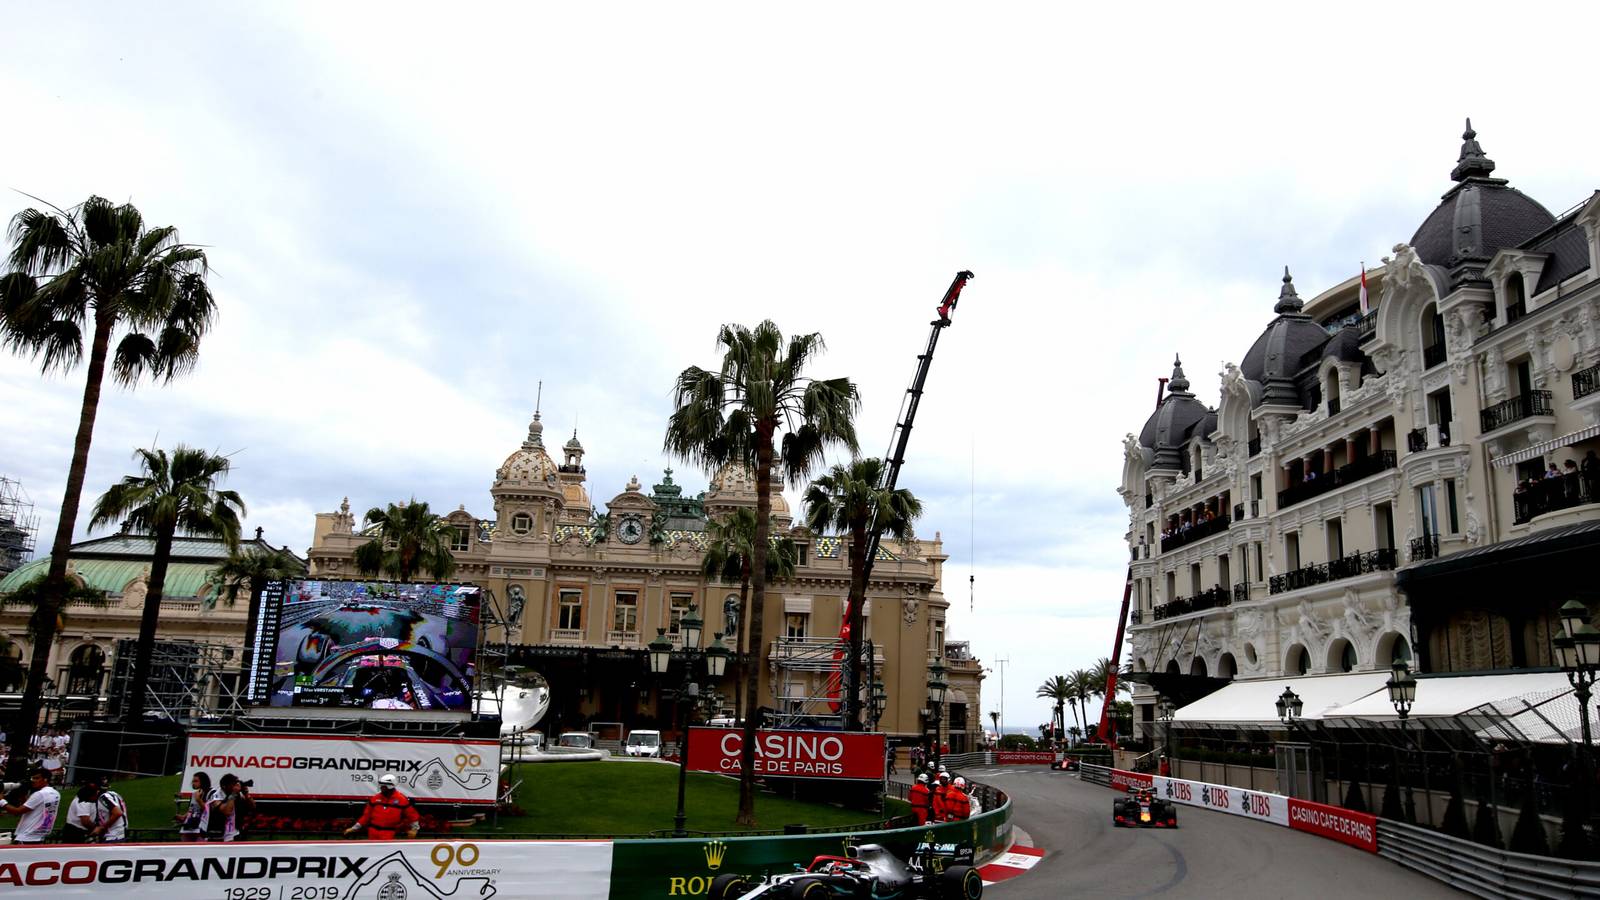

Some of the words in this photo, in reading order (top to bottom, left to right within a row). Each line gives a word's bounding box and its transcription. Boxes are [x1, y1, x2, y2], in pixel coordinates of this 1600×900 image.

[190, 755, 422, 772] MONACOGRANDPRIX
[454, 754, 481, 773] 90
[720, 759, 762, 771] CAE
[768, 761, 789, 772] DE
[794, 762, 843, 774] PARIS
[351, 774, 374, 782] 1929
[1174, 782, 1192, 801] UBS
[1211, 788, 1229, 808] UBS
[1252, 795, 1270, 817] UBS
[1292, 806, 1319, 825] CASINO
[1320, 812, 1340, 832] CAFE
[1340, 818, 1350, 835] DE
[1352, 821, 1372, 843] PARIS
[431, 843, 480, 879] 90
[224, 887, 271, 900] 1929
[290, 886, 338, 900] 2019
